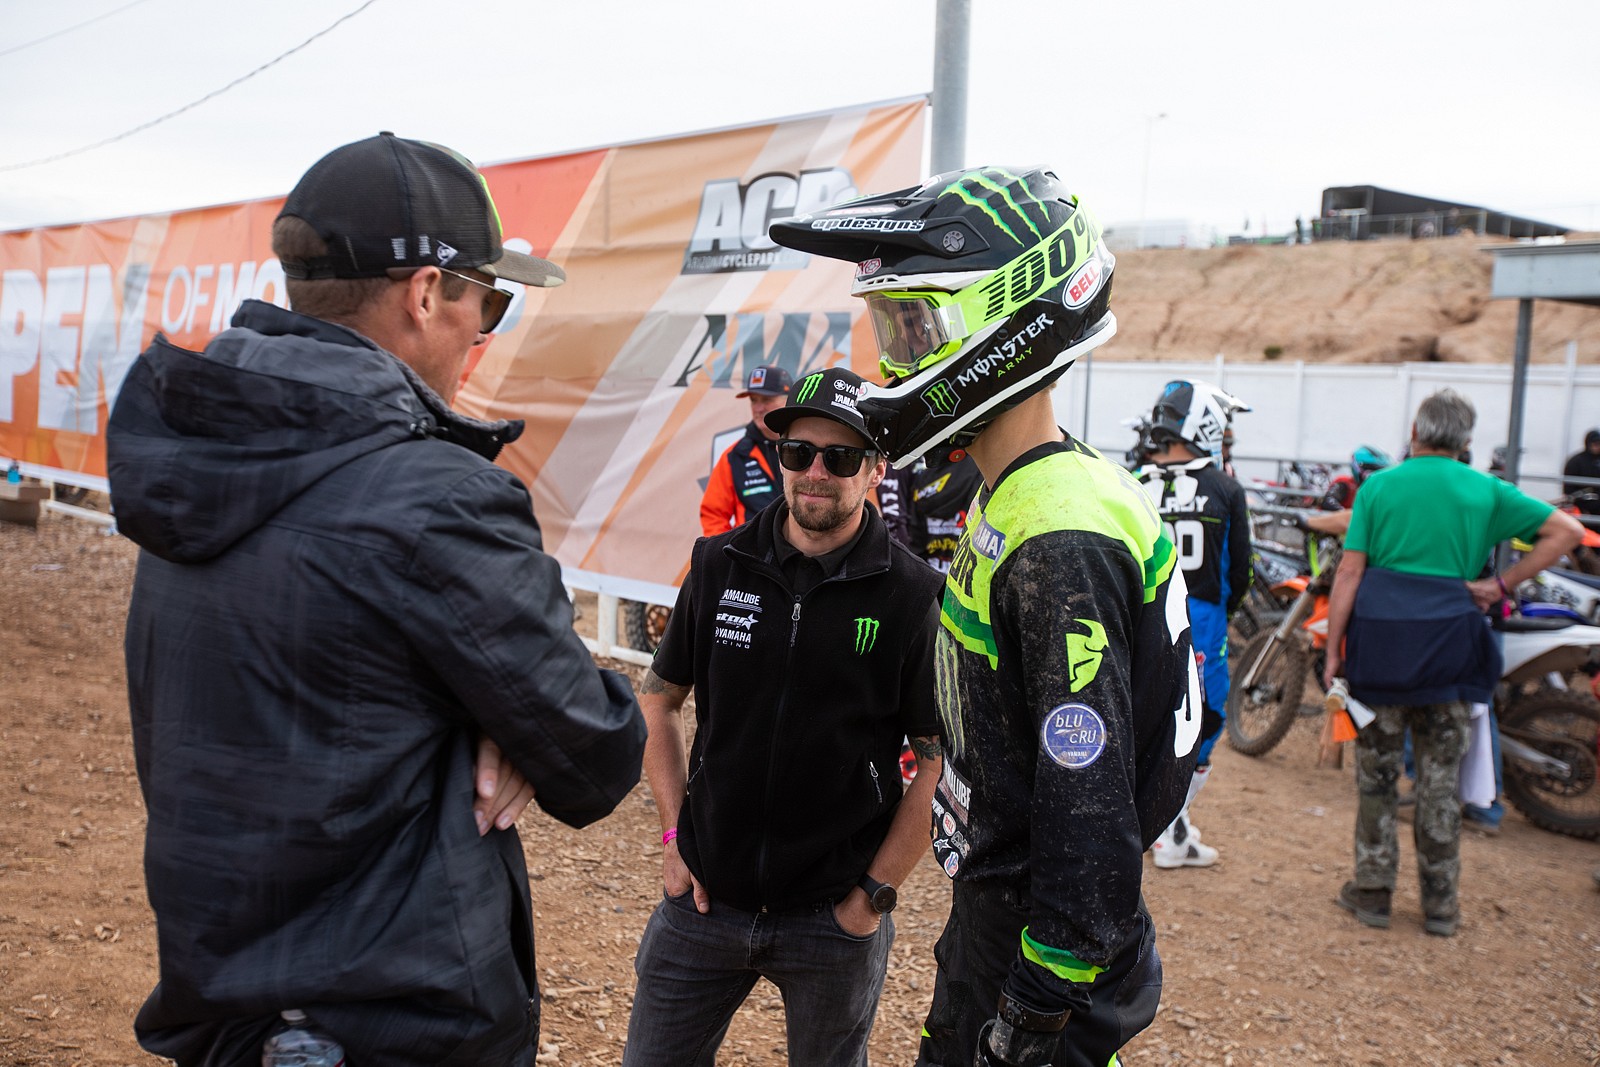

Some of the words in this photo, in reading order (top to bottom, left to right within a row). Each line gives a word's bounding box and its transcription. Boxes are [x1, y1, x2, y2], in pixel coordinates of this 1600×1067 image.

[161, 265, 216, 335] OF
[1069, 265, 1099, 303] BELL
[669, 313, 852, 389] AMA
[957, 312, 1055, 387] MONSTER
[997, 346, 1033, 378] ARMY
[881, 478, 900, 516] FLY
[719, 628, 751, 643] YAMAHA
